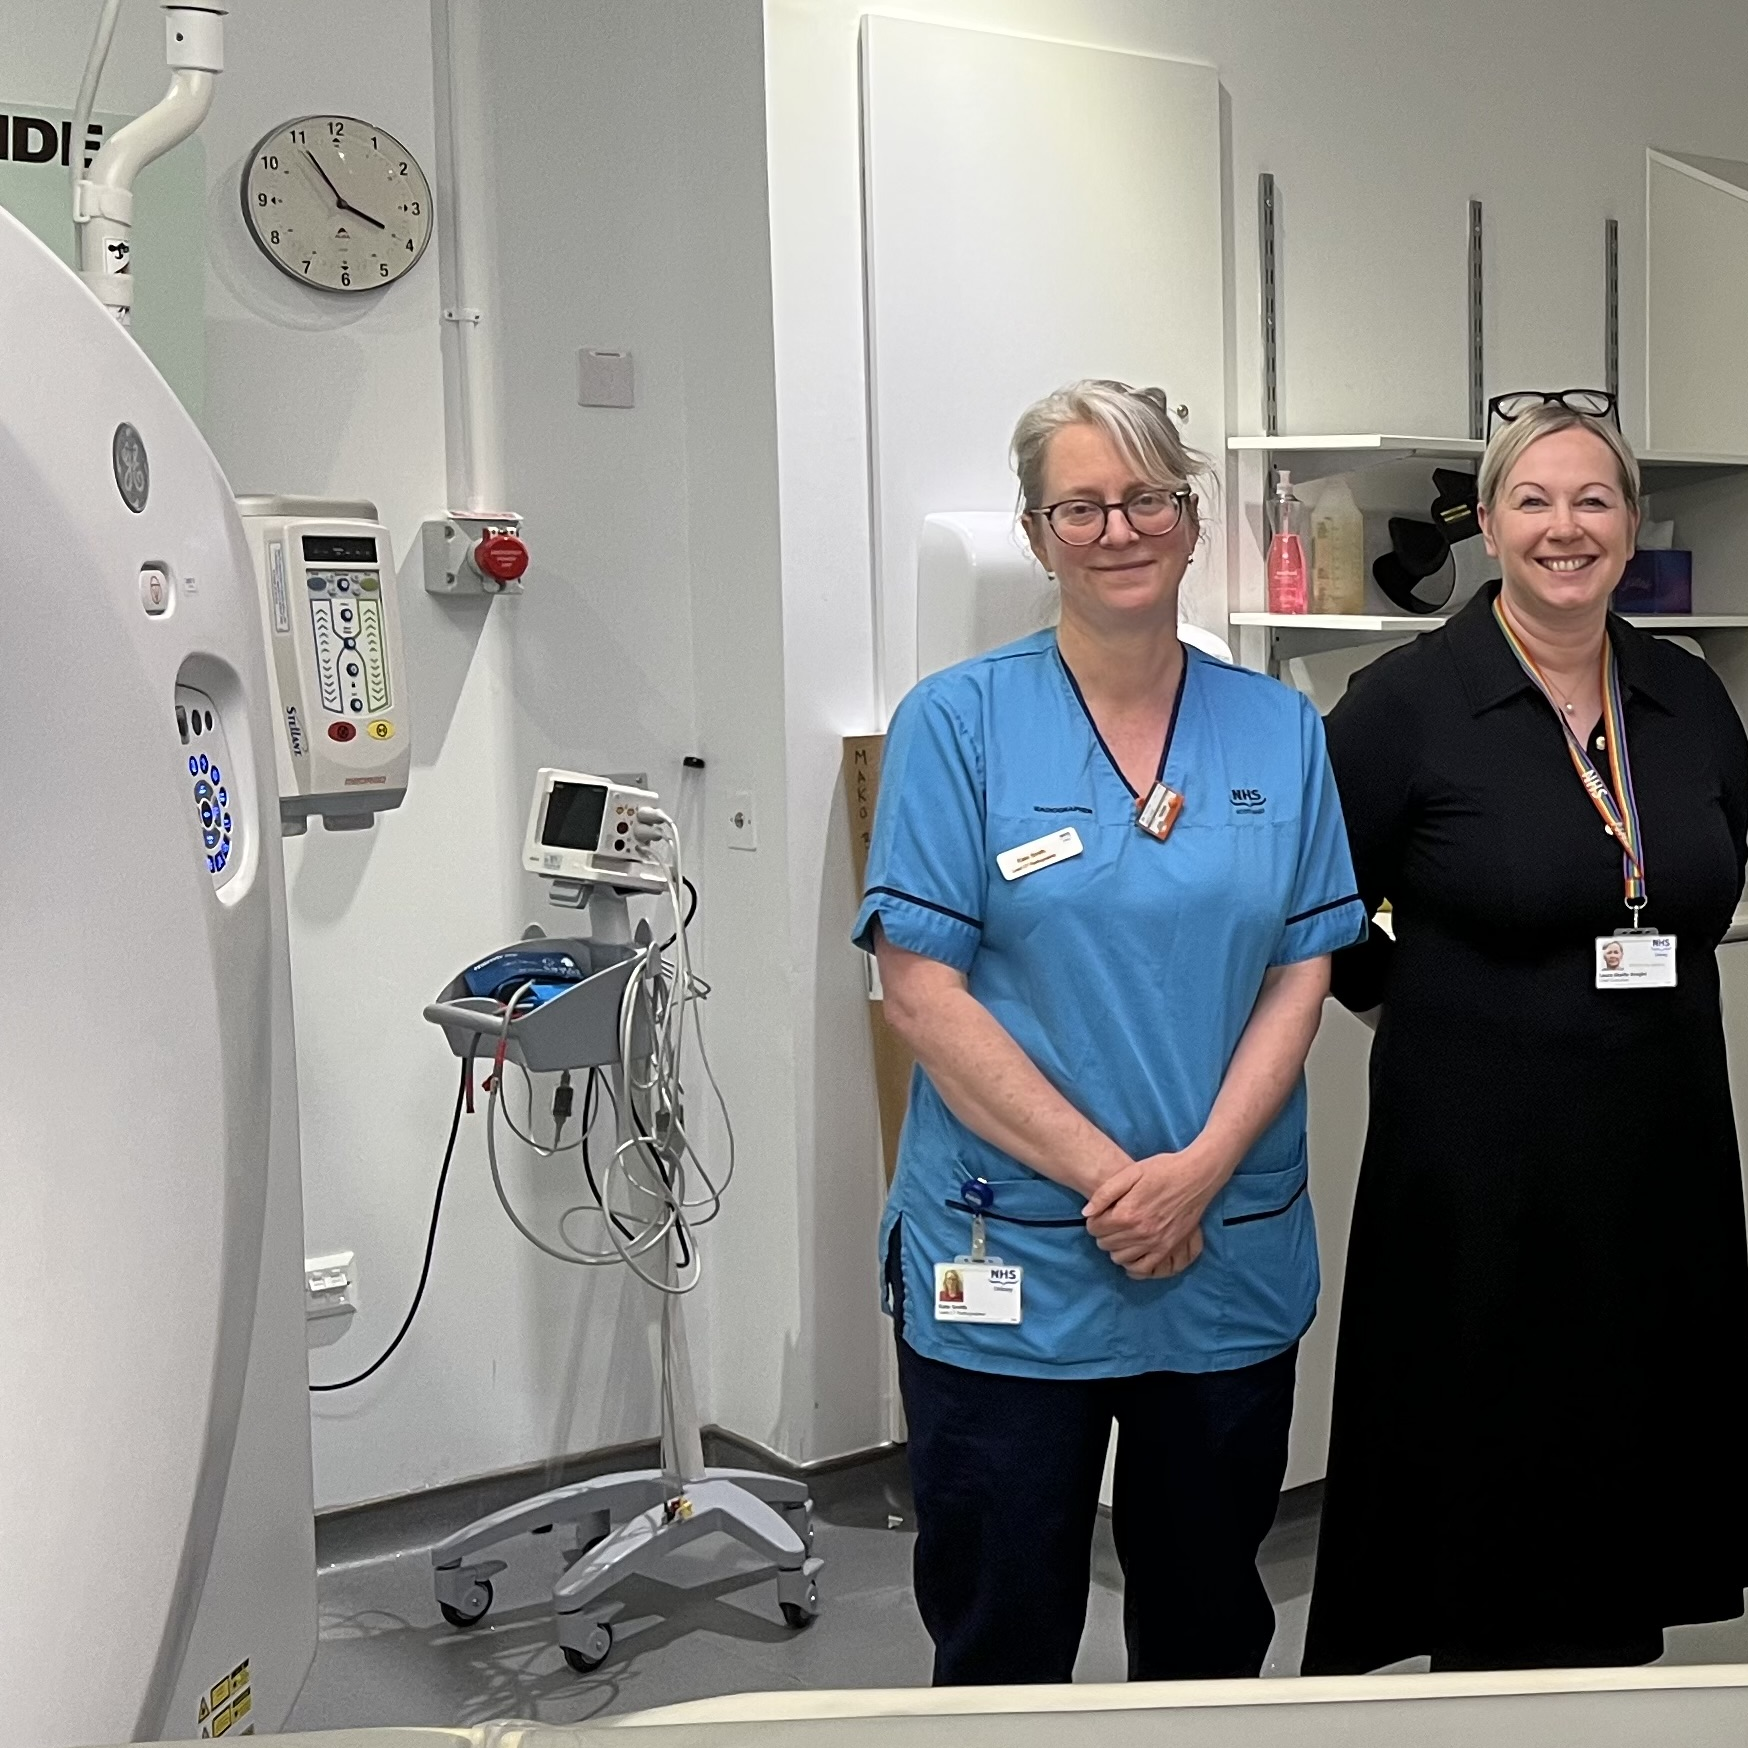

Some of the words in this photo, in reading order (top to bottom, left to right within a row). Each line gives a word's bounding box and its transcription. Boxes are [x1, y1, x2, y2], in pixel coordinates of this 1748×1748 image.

[327, 122, 345, 137] 12
[290, 130, 306, 145] 11
[371, 136, 378, 151] 1
[261, 155, 279, 171] 10
[399, 161, 408, 177] 2
[257, 192, 267, 207] 9
[411, 201, 421, 216] 3
[270, 230, 280, 245] 8
[405, 238, 414, 253] 4
[301, 260, 311, 275] 7
[379, 263, 389, 278] 5
[341, 272, 351, 287] 6
[1581, 769, 1608, 799] NHS
[1231, 789, 1262, 801] NHS
[1652, 939, 1671, 947] NHS
[990, 1269, 1017, 1280] NHS
